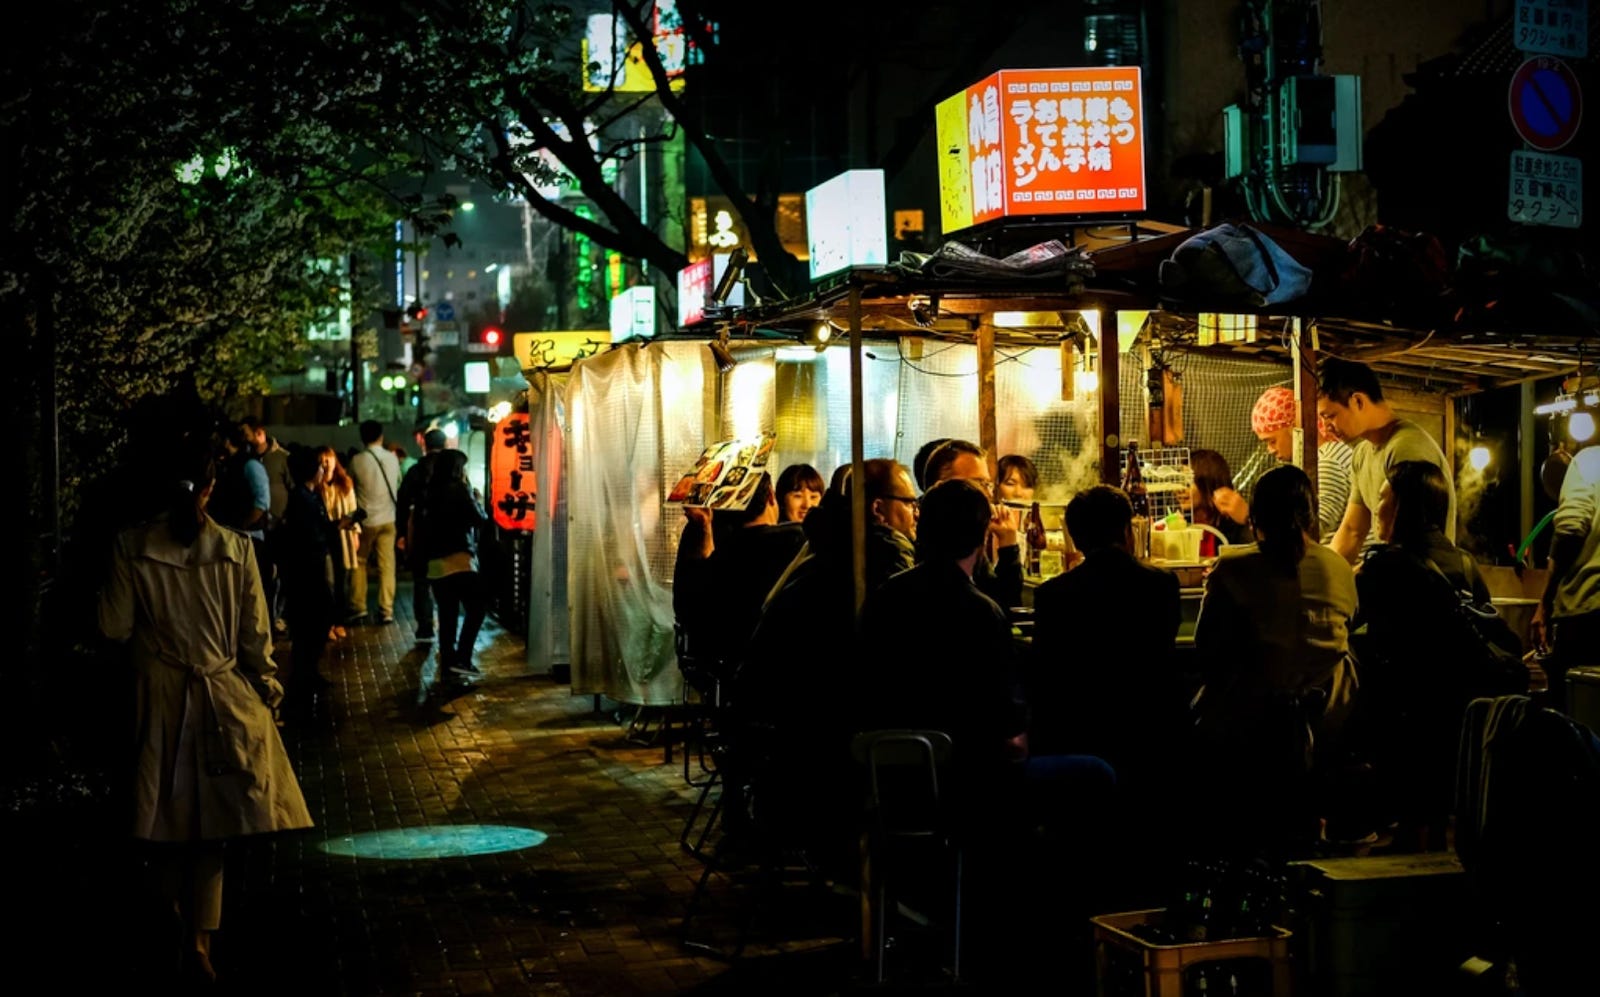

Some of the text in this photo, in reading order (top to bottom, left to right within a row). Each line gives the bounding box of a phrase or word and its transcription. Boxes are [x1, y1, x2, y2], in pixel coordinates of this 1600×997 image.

[1010, 100, 1037, 187] ラーメン
[1109, 96, 1135, 144] もつ
[1513, 199, 1577, 219] タクシー
